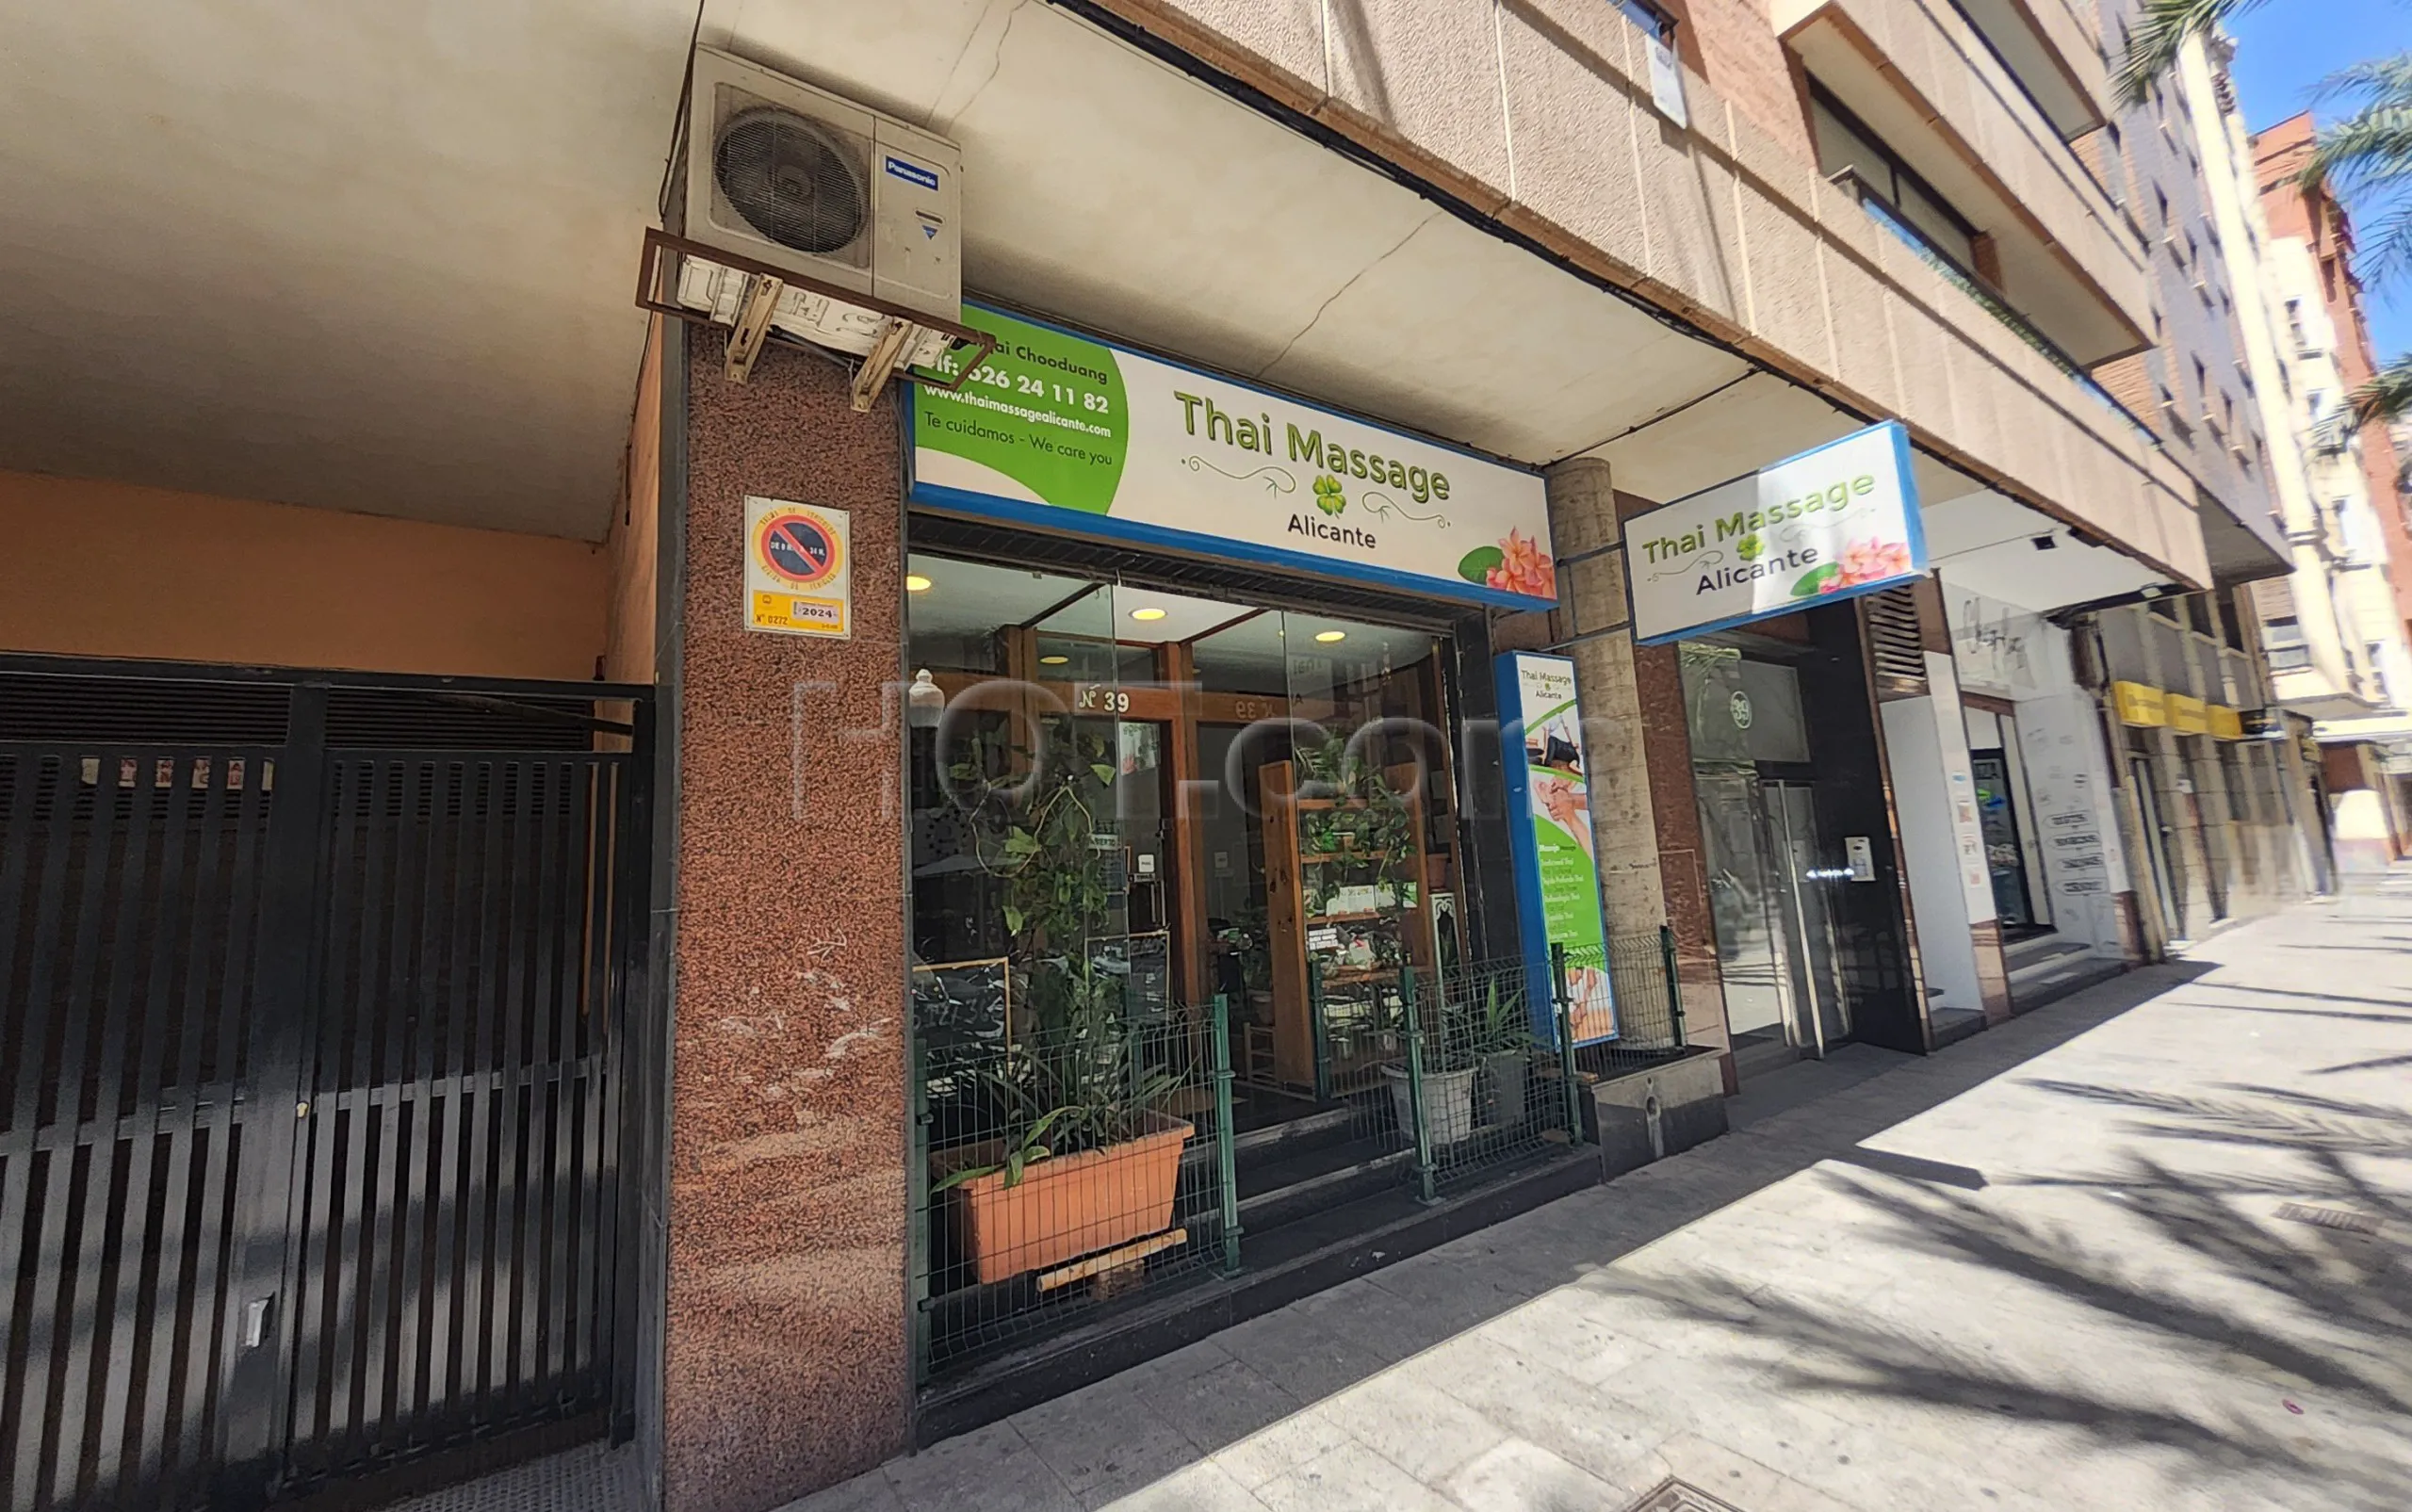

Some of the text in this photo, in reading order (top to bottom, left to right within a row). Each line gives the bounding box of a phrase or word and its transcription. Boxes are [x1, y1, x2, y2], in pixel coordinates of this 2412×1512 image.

[888, 160, 937, 187] Panasonic
[1015, 346, 1109, 385] Chooduang
[923, 384, 1112, 438] www.thaimassagealicante.com
[1017, 375, 1044, 398] 24
[1052, 383, 1075, 405] 11
[1083, 392, 1109, 414] 82
[924, 411, 941, 429] Te
[945, 415, 1015, 445] cuidamos
[1029, 433, 1053, 453] We
[1056, 444, 1086, 460] care
[1088, 452, 1113, 466] you
[1173, 389, 1451, 504] Thai Massage
[1287, 512, 1377, 549] Alicante
[1641, 474, 1875, 565] Thai Massage
[1696, 546, 1818, 595] Alicante
[768, 615, 789, 626] 0272
[802, 607, 833, 618] 2024
[1521, 669, 1572, 687] Thai Massage
[1535, 690, 1562, 700] Alicante
[1103, 691, 1130, 713] 39
[1734, 699, 1750, 721] 39
